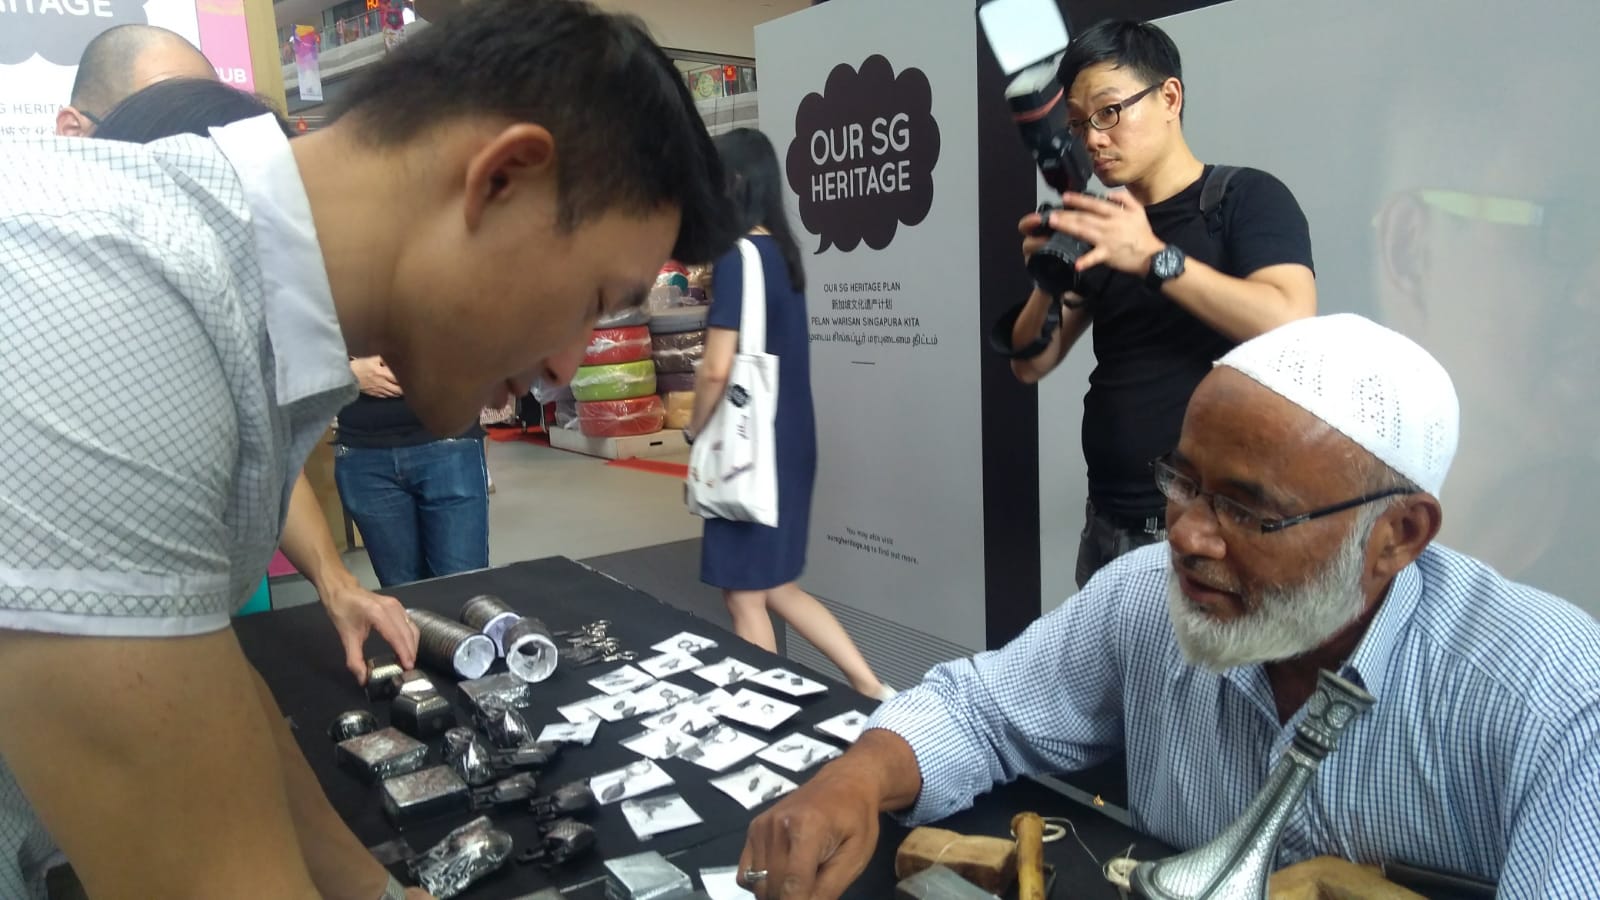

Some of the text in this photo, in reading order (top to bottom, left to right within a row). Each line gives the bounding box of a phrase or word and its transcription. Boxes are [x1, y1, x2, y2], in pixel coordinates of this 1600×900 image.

[810, 112, 909, 165] OUR SG
[811, 160, 911, 202] HERITAGE
[823, 282, 901, 293] OUR SG HERITAGE PLAN
[831, 298, 893, 310] 新加坡文化遗产计划
[811, 316, 920, 327] PELAN WARISAN SINGAPURA KITA
